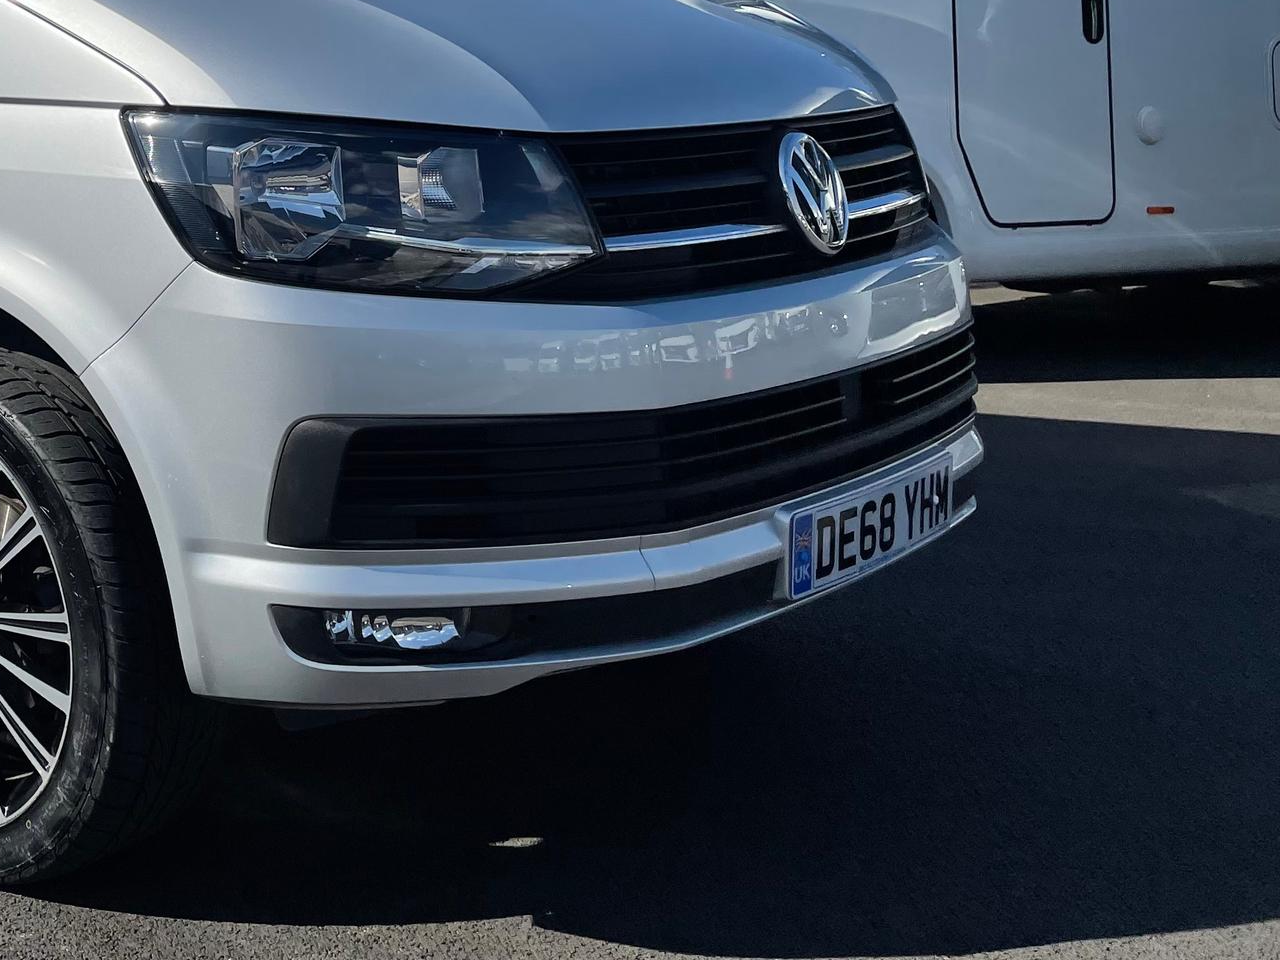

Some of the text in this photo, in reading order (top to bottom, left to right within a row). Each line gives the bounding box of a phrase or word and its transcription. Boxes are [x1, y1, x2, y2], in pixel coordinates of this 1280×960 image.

[815, 465, 950, 580] DE68 YHM
[794, 563, 811, 583] UK
